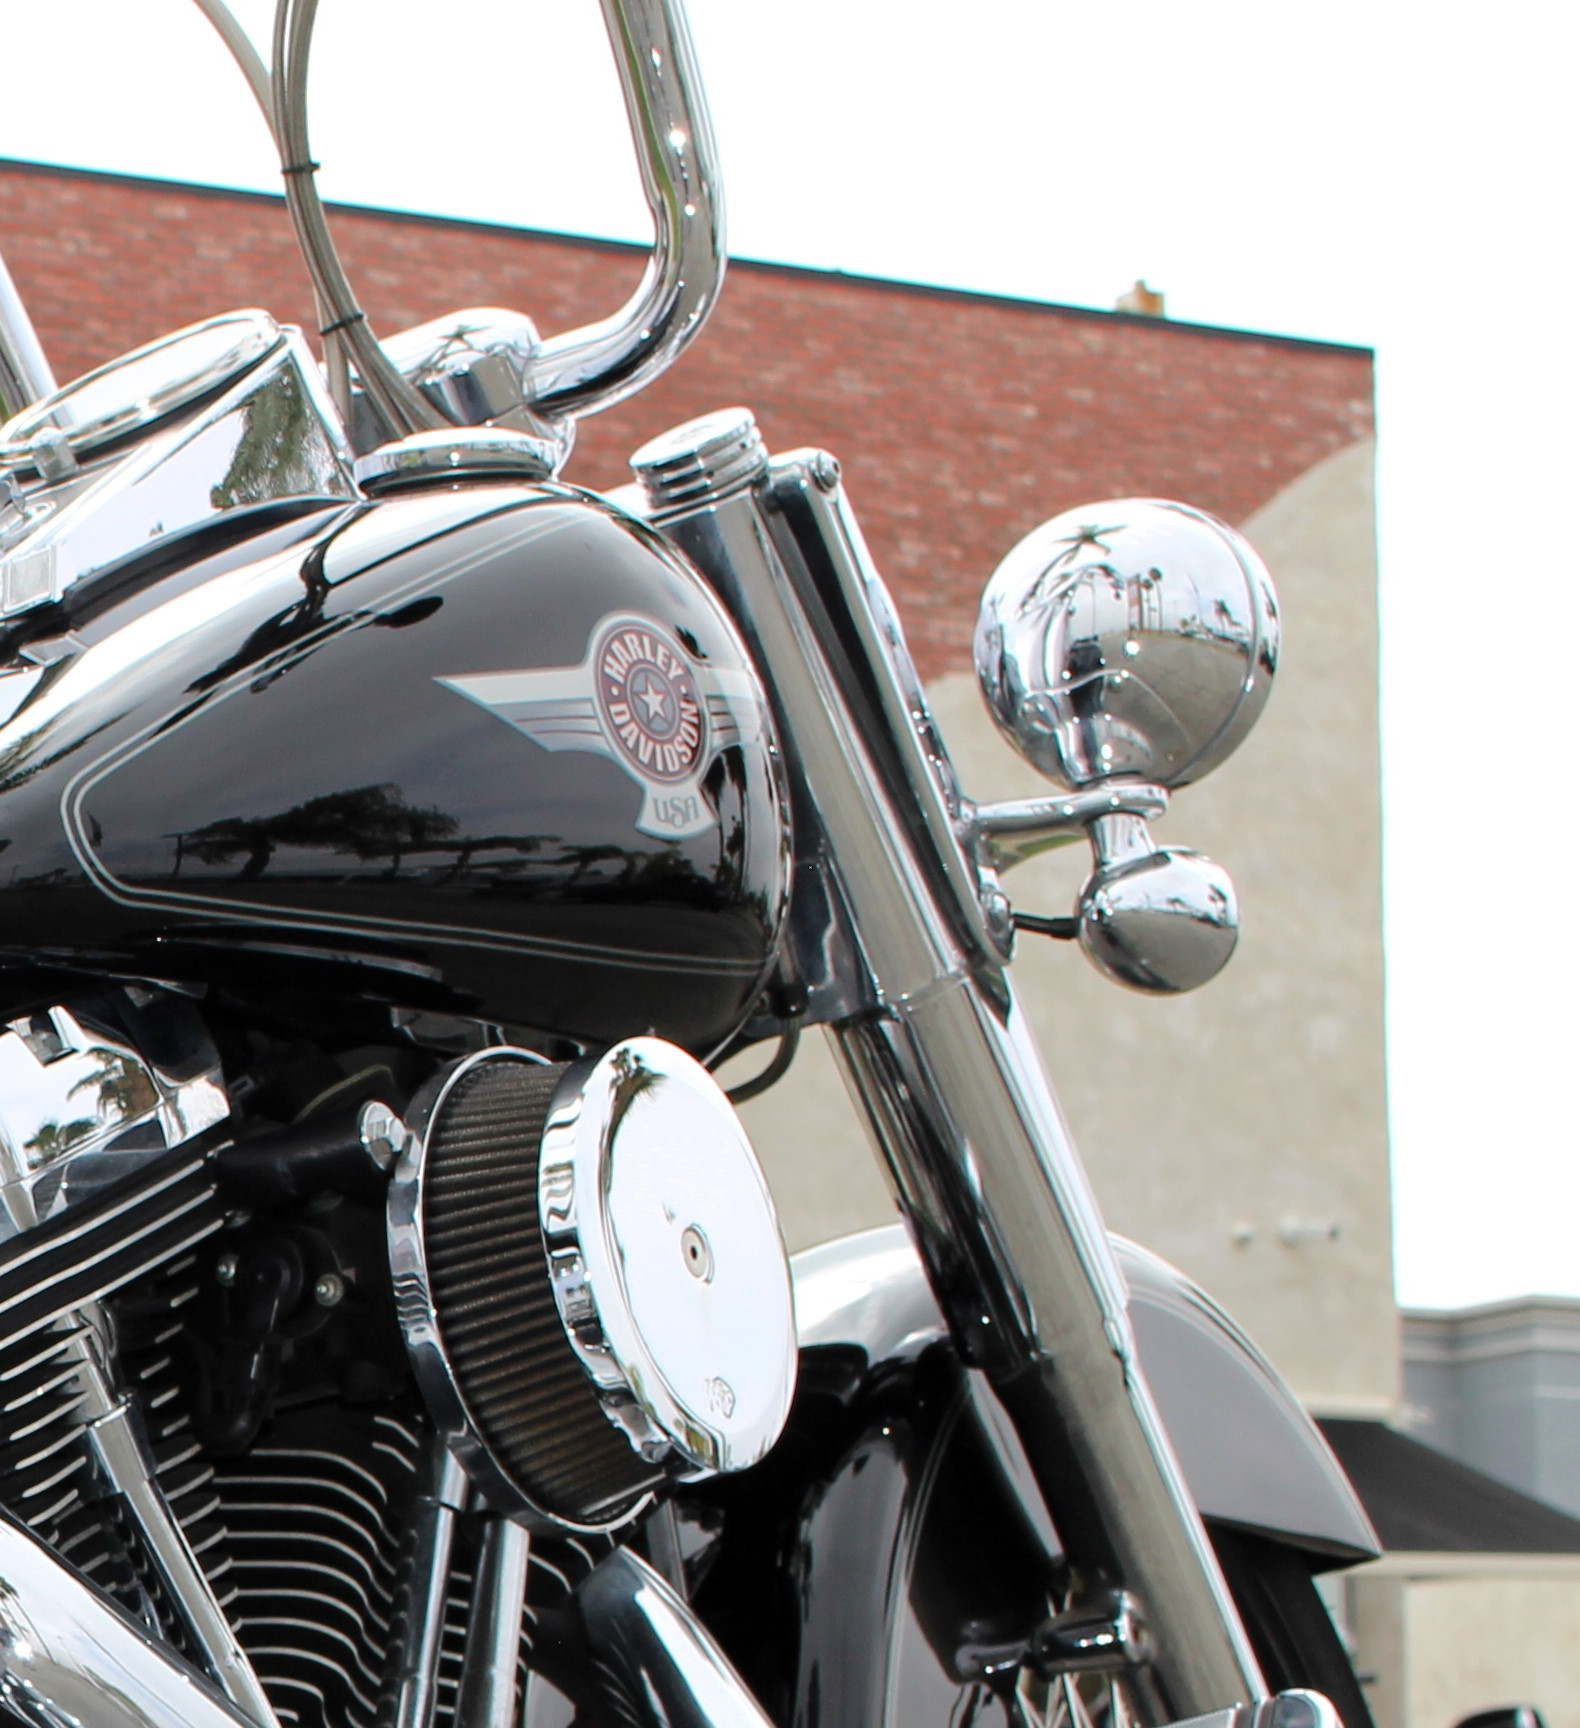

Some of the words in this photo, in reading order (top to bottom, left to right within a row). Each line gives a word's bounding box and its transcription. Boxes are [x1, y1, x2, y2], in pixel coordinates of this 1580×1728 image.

[602, 631, 686, 684] HARLEY
[607, 699, 700, 773] DAVIDSON
[651, 797, 700, 828] USA
